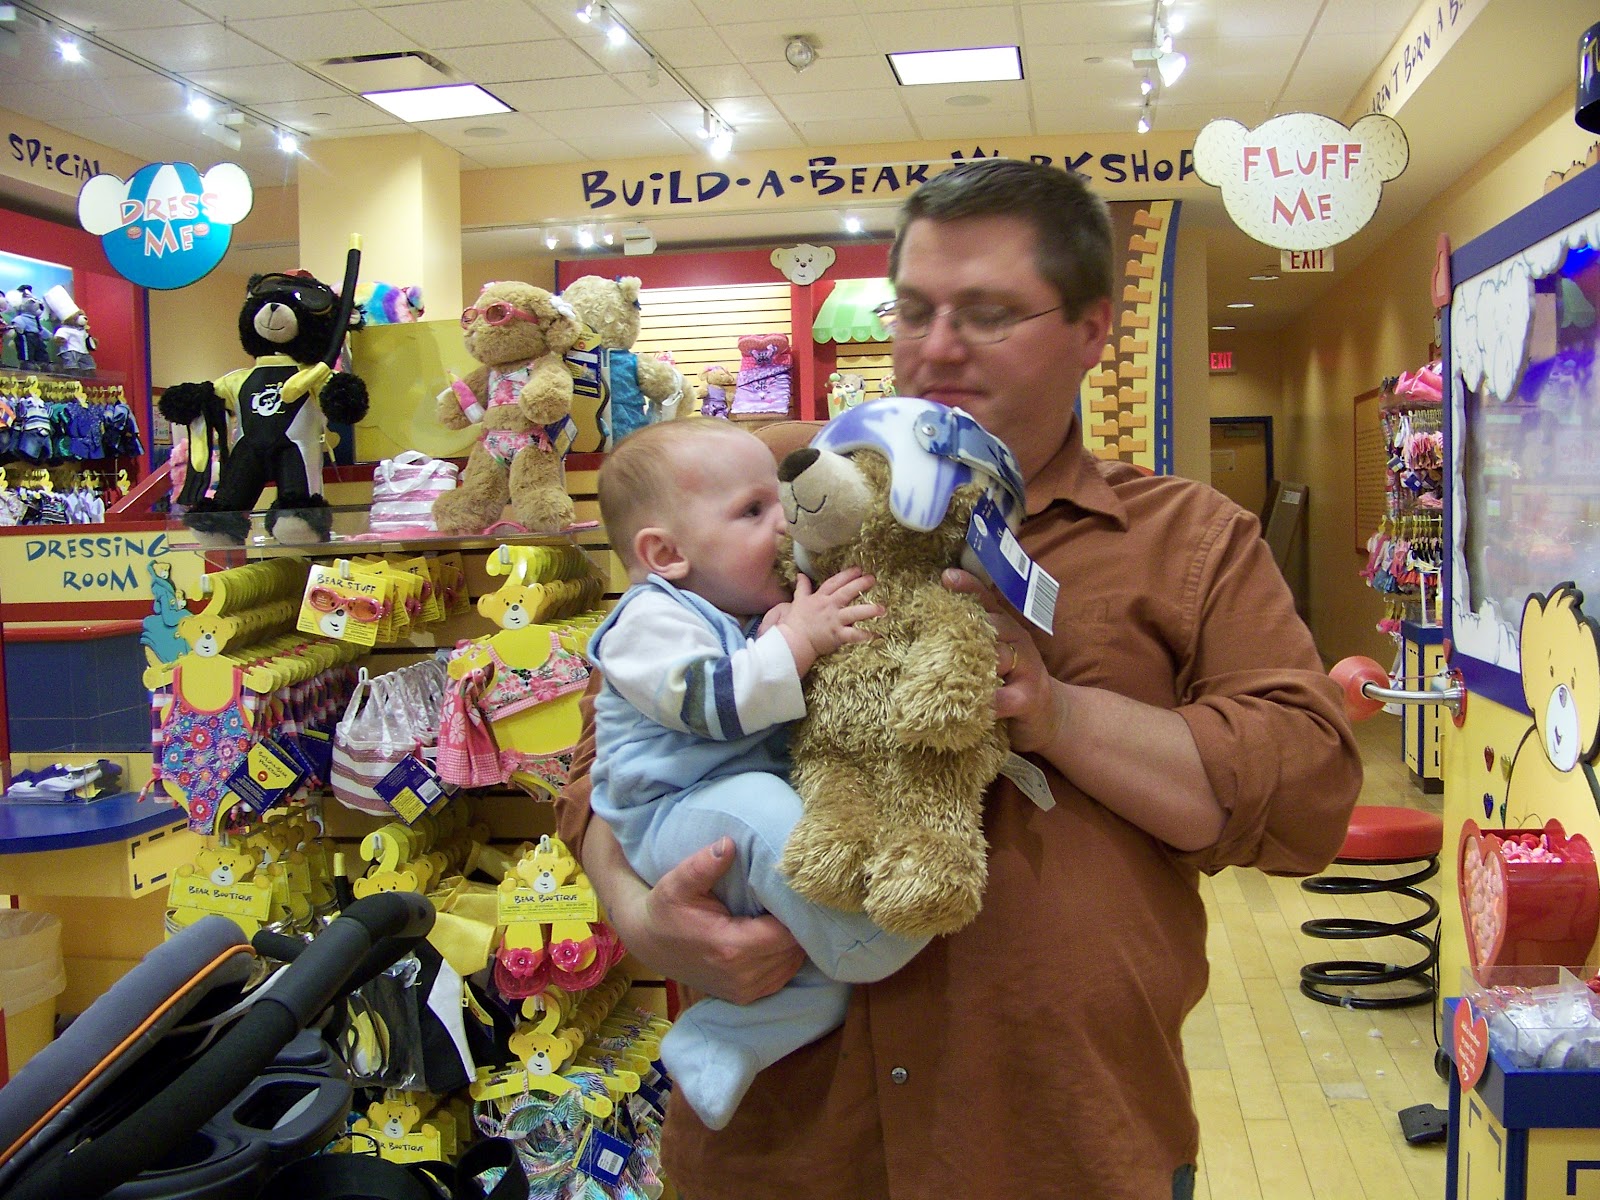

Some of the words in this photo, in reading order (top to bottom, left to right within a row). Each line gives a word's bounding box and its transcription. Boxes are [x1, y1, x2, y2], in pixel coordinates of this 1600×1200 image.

[1404, 25, 1431, 83] BORN
[1436, 6, 1443, 41] A
[1243, 144, 1362, 182] FLUFF
[119, 192, 221, 226] DRESS
[1272, 187, 1331, 226] ME
[144, 220, 194, 258] ME
[1290, 250, 1323, 269] EXIT
[1210, 352, 1232, 369] EXIT
[26, 533, 171, 561] DRESSiNG
[63, 564, 139, 592] ROOM
[317, 574, 344, 588] BEAR
[347, 581, 376, 594] STUFF
[188, 885, 210, 896] BEAR
[213, 888, 253, 902] BOUTiQUE
[514, 895, 535, 904] BEAR
[538, 894, 578, 903] BOUTiQUE
[367, 1139, 386, 1149] BR
[388, 1142, 424, 1152] BOUTiQUE
